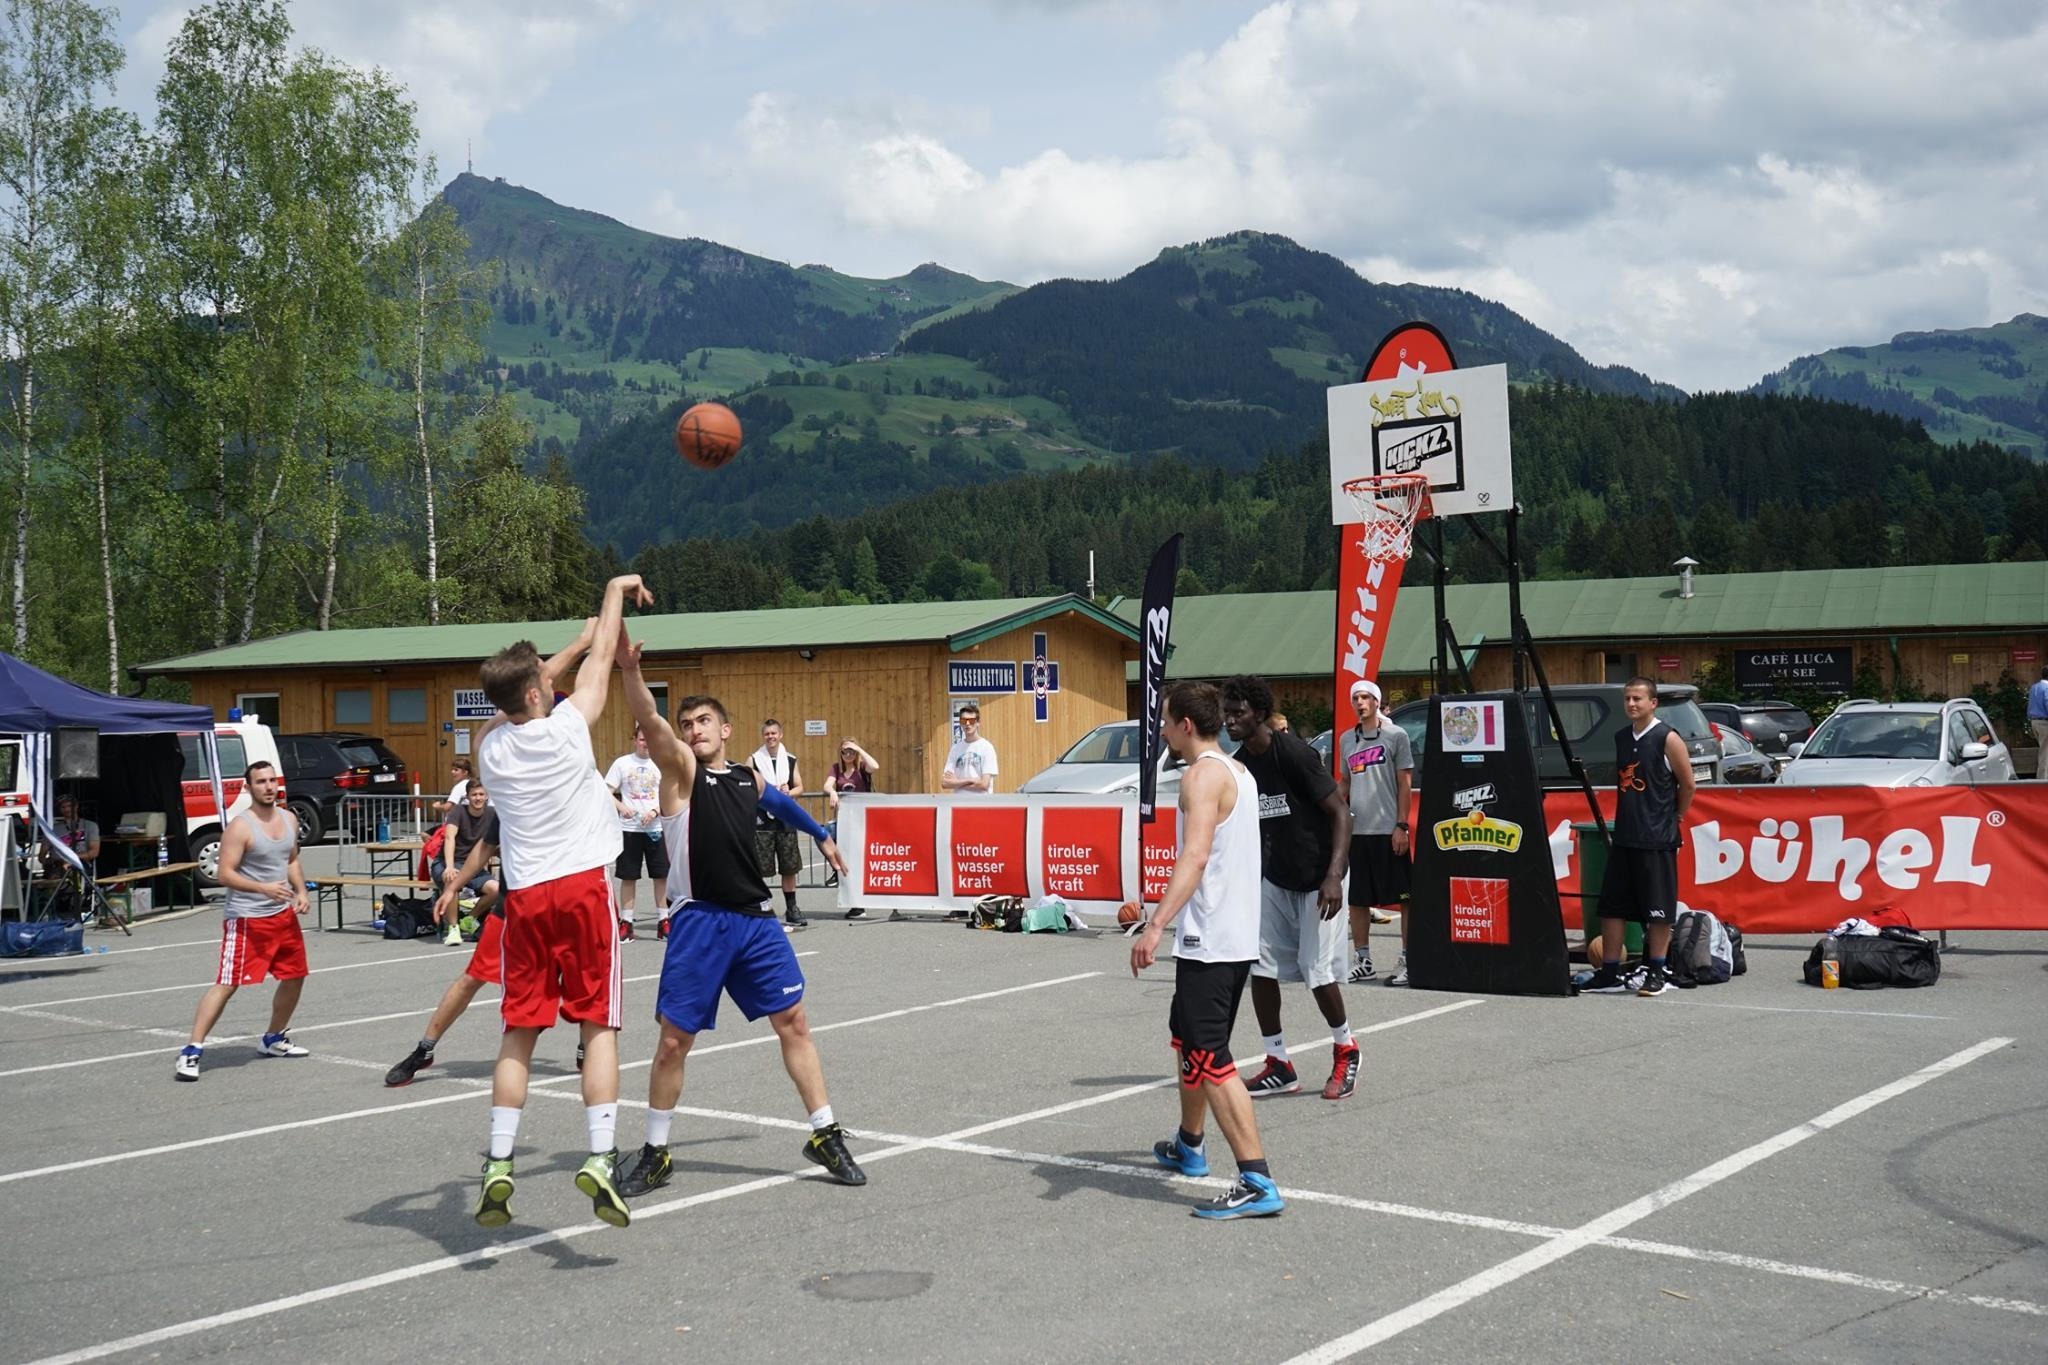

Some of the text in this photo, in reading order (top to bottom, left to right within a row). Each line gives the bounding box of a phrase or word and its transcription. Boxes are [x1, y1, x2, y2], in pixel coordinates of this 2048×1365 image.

[1794, 653, 1834, 664] LUCA
[951, 667, 1014, 687] WASSERRETTUNG
[1793, 668, 1816, 677] SEE
[870, 842, 911, 856] tiroler
[956, 843, 998, 857] tiroler
[1048, 844, 1092, 858] tiroler
[1145, 845, 1177, 860] tirol
[869, 861, 917, 871] wasser
[957, 862, 1005, 873] wasser
[1048, 864, 1099, 875] wasser
[1144, 865, 1173, 877] was
[869, 873, 902, 887] kraft
[959, 875, 992, 888] kraft
[1049, 877, 1084, 891] kraft
[1145, 879, 1168, 894] kra
[1455, 904, 1487, 915] tiroler
[1455, 918, 1492, 927] wasser
[1456, 928, 1481, 939] kraft
